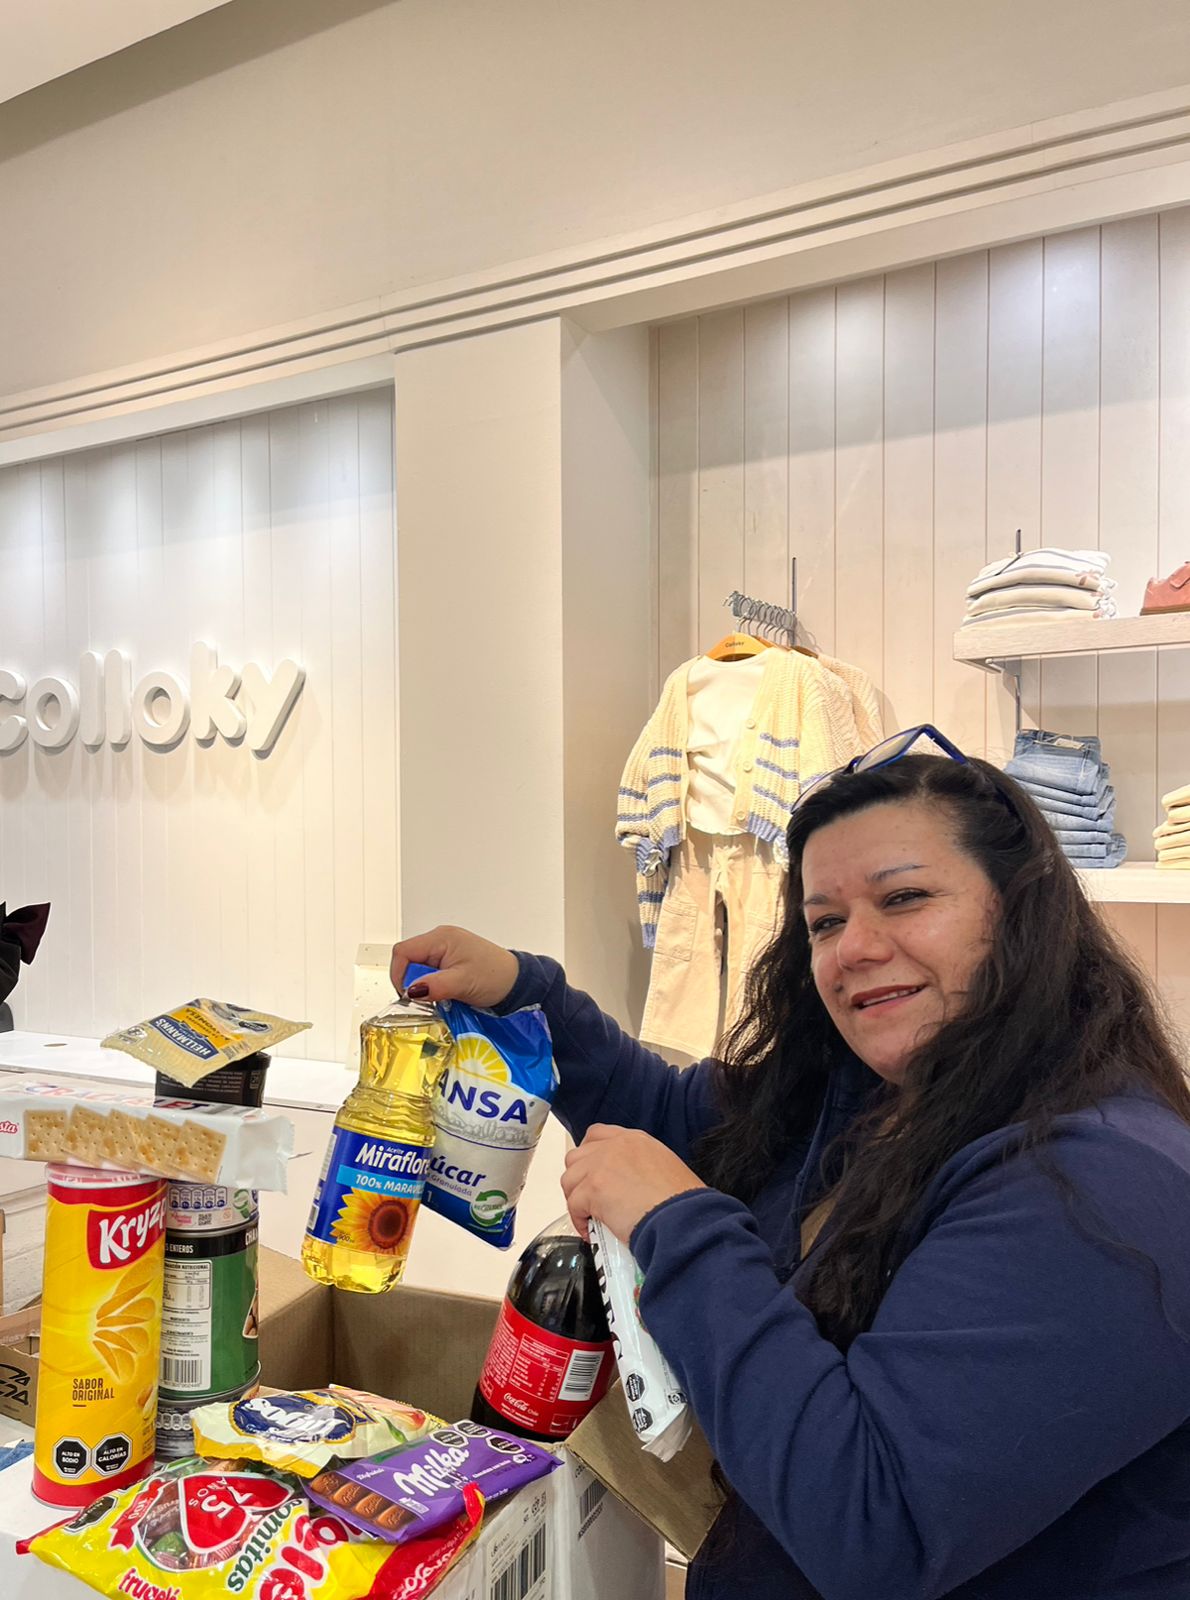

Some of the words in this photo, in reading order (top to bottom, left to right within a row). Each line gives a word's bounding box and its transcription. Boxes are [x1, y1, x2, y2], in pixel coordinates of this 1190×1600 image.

[0, 641, 306, 760] colloky
[438, 1068, 528, 1125] ANSA
[354, 1142, 430, 1175] Miraflor
[430, 1155, 486, 1187] úcar
[355, 1174, 382, 1189] 100%
[98, 1198, 166, 1264] Kryzp
[72, 1377, 104, 1390] SABOR
[72, 1387, 115, 1401] ORIGINAL
[393, 1446, 470, 1497] Milka
